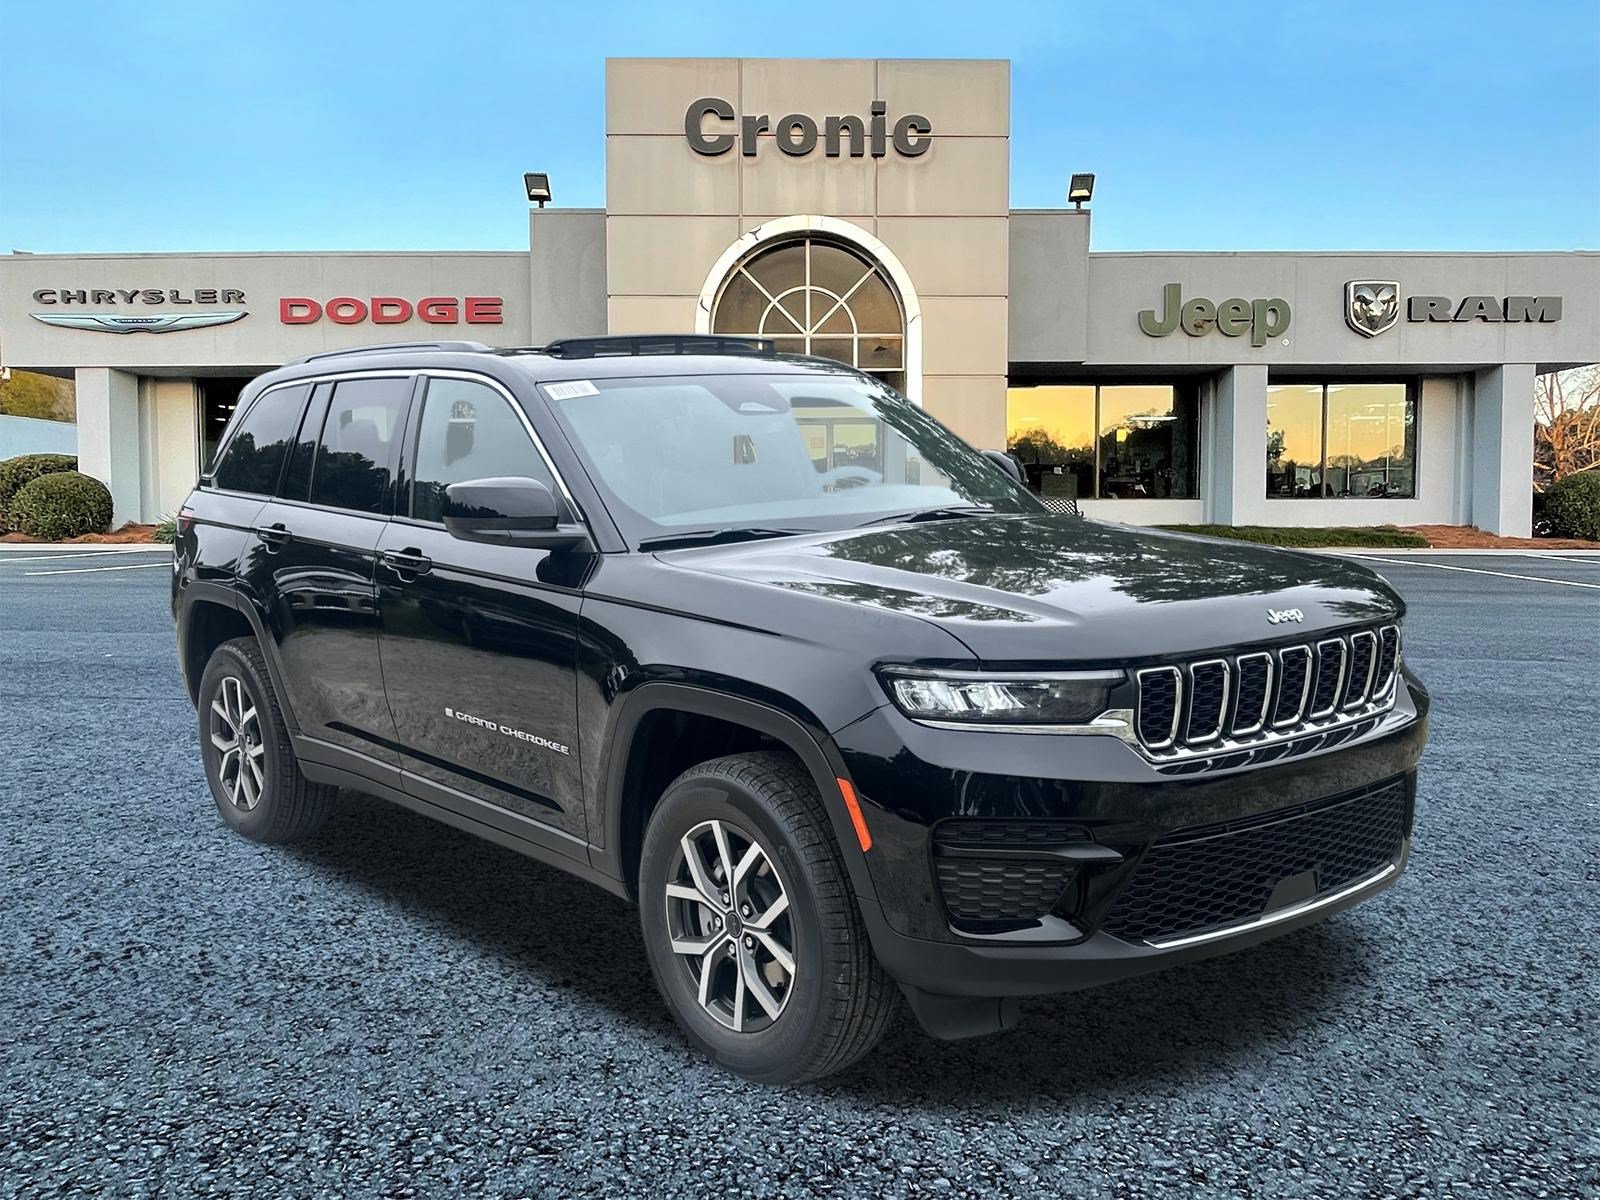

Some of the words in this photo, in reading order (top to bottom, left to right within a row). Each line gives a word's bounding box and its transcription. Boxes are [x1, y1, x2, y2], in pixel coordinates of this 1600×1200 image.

[684, 98, 932, 158] Cronic
[32, 288, 246, 304] CHRYSLER
[279, 296, 504, 325] DODGE
[1407, 296, 1563, 323] RAM
[1137, 283, 1292, 347] Jeep
[1266, 608, 1304, 624] Jeep
[455, 711, 498, 731] GRAND
[499, 724, 570, 756] CHEROKEE
